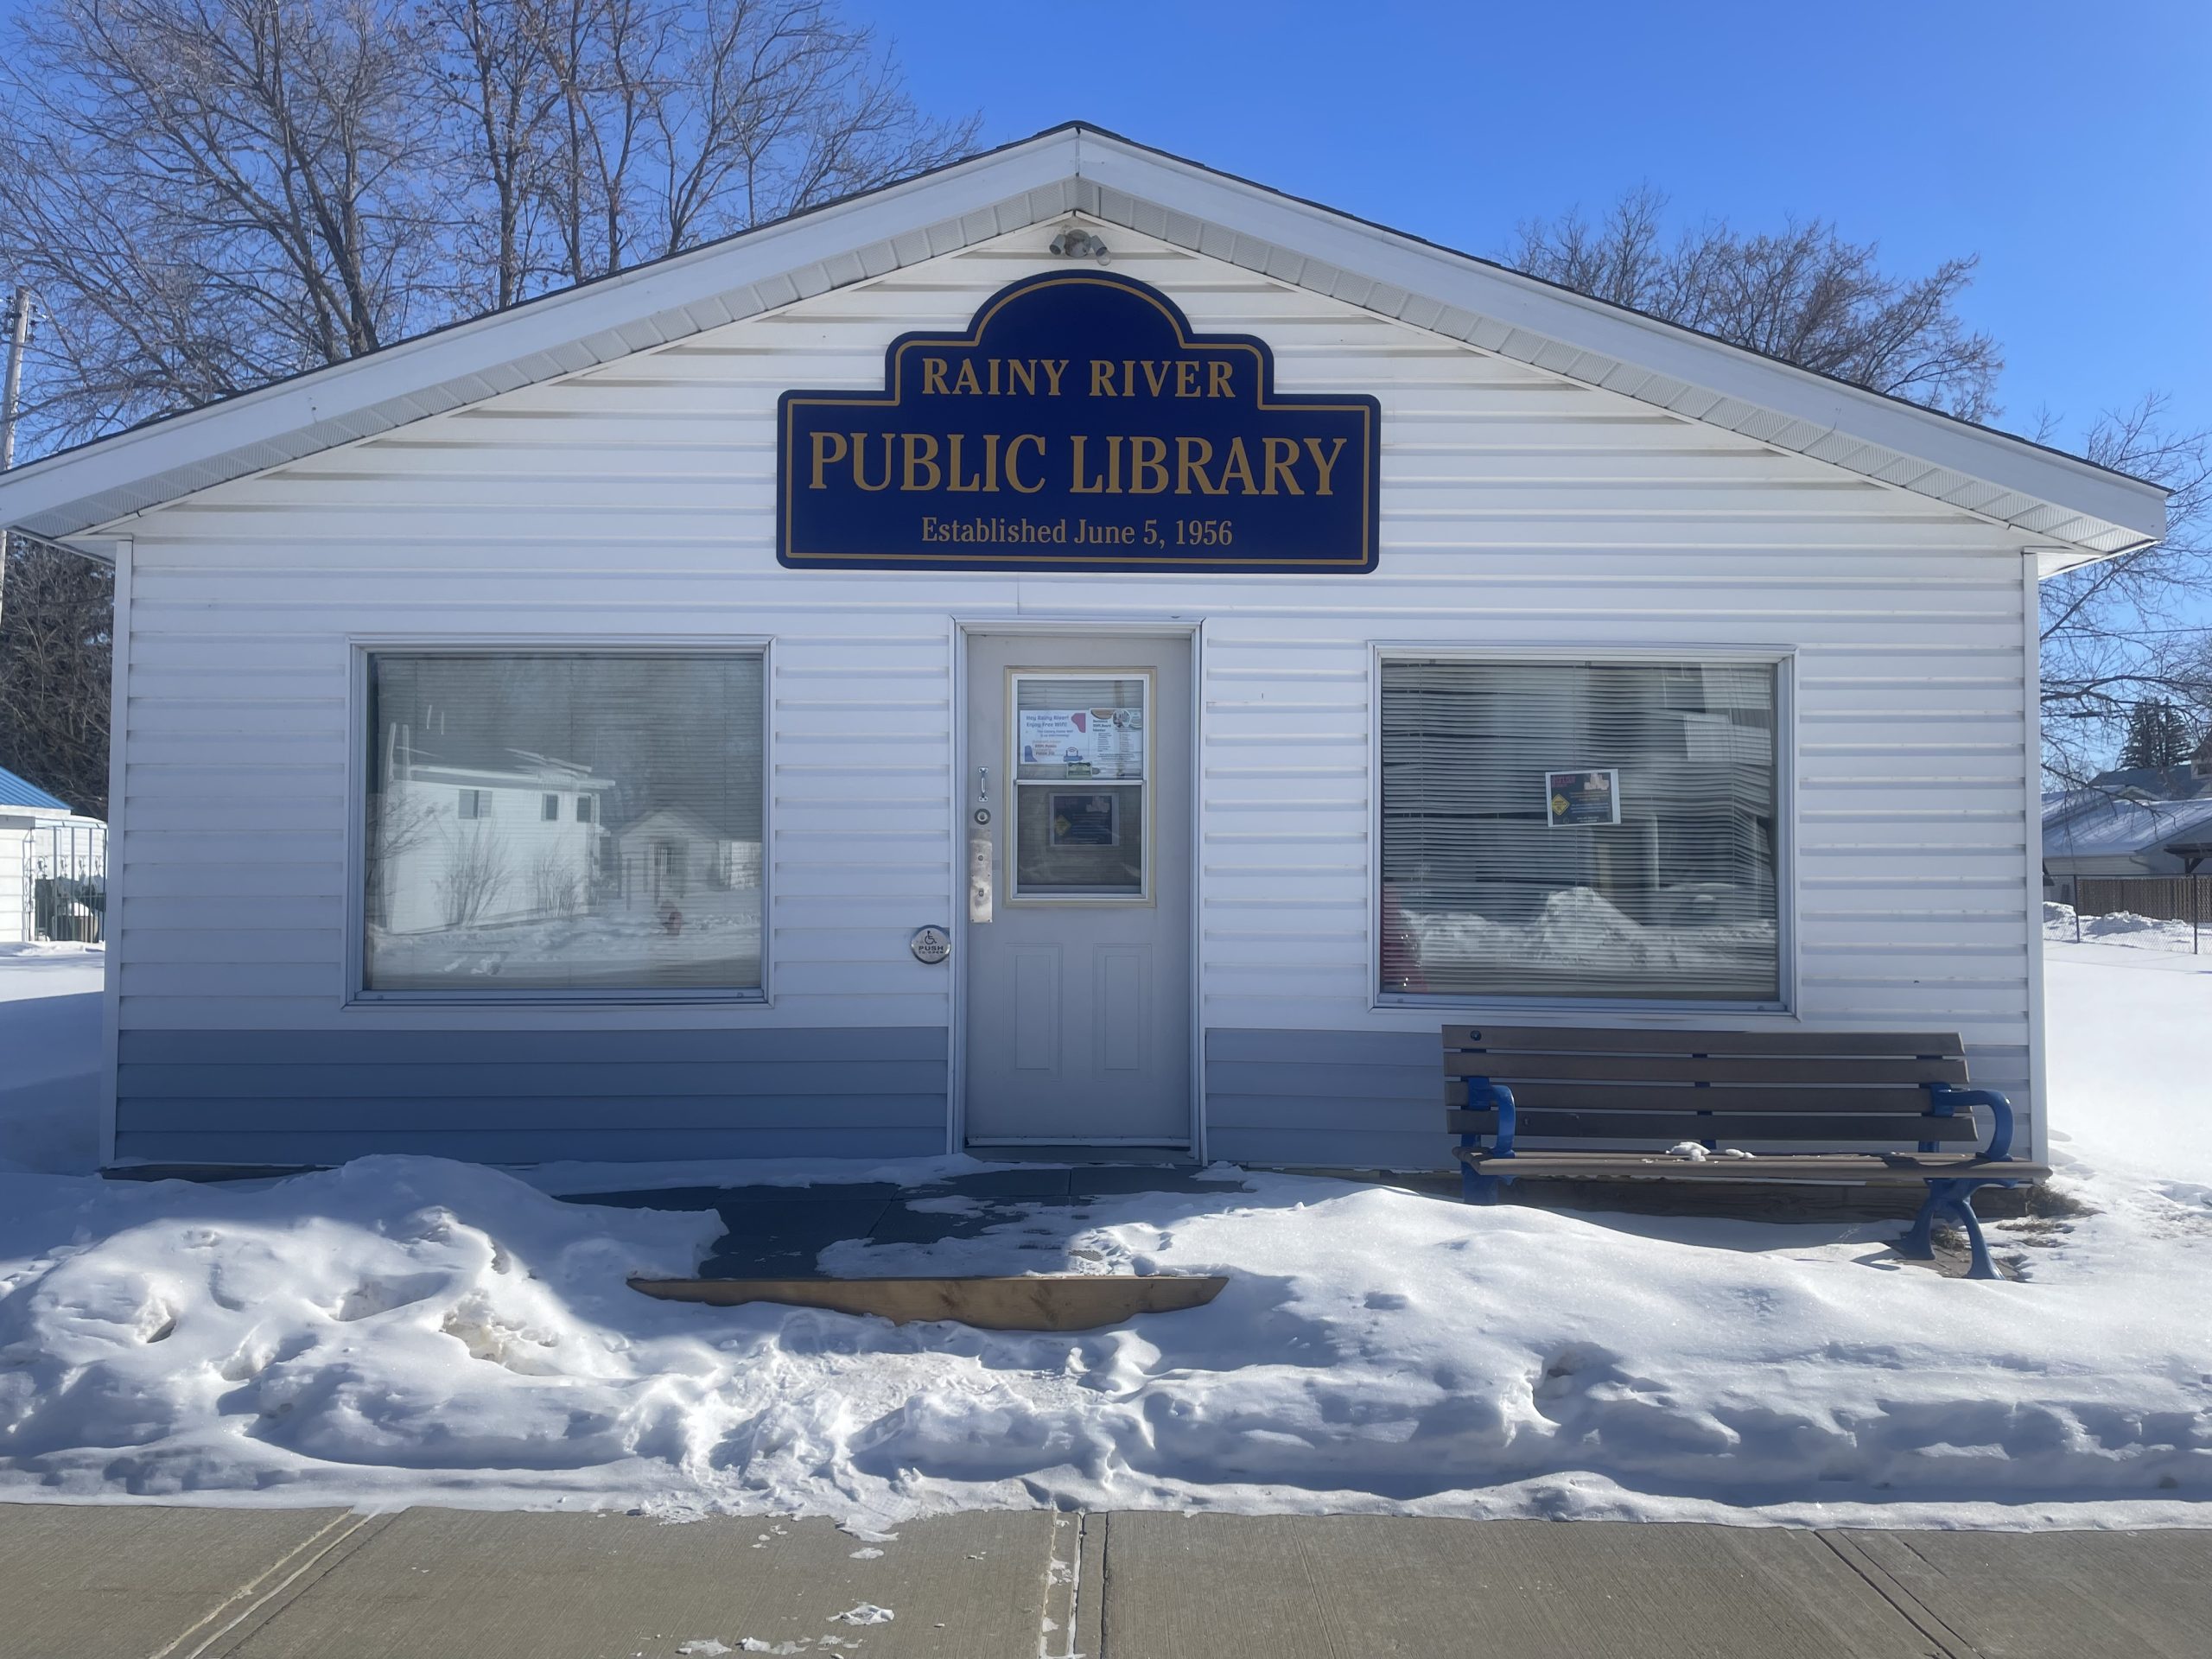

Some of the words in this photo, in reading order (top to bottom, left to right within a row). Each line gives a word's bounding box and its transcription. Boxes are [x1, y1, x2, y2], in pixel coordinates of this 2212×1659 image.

[922, 357, 1069, 397] RAINY
[1090, 359, 1236, 398] RIVER
[809, 431, 1046, 494] PUBLIC
[1070, 435, 1347, 496] LIBRARY
[921, 517, 1066, 543] Established
[1074, 518, 1135, 544] June
[1143, 519, 1166, 549] 5,
[1176, 520, 1233, 546] 1956
